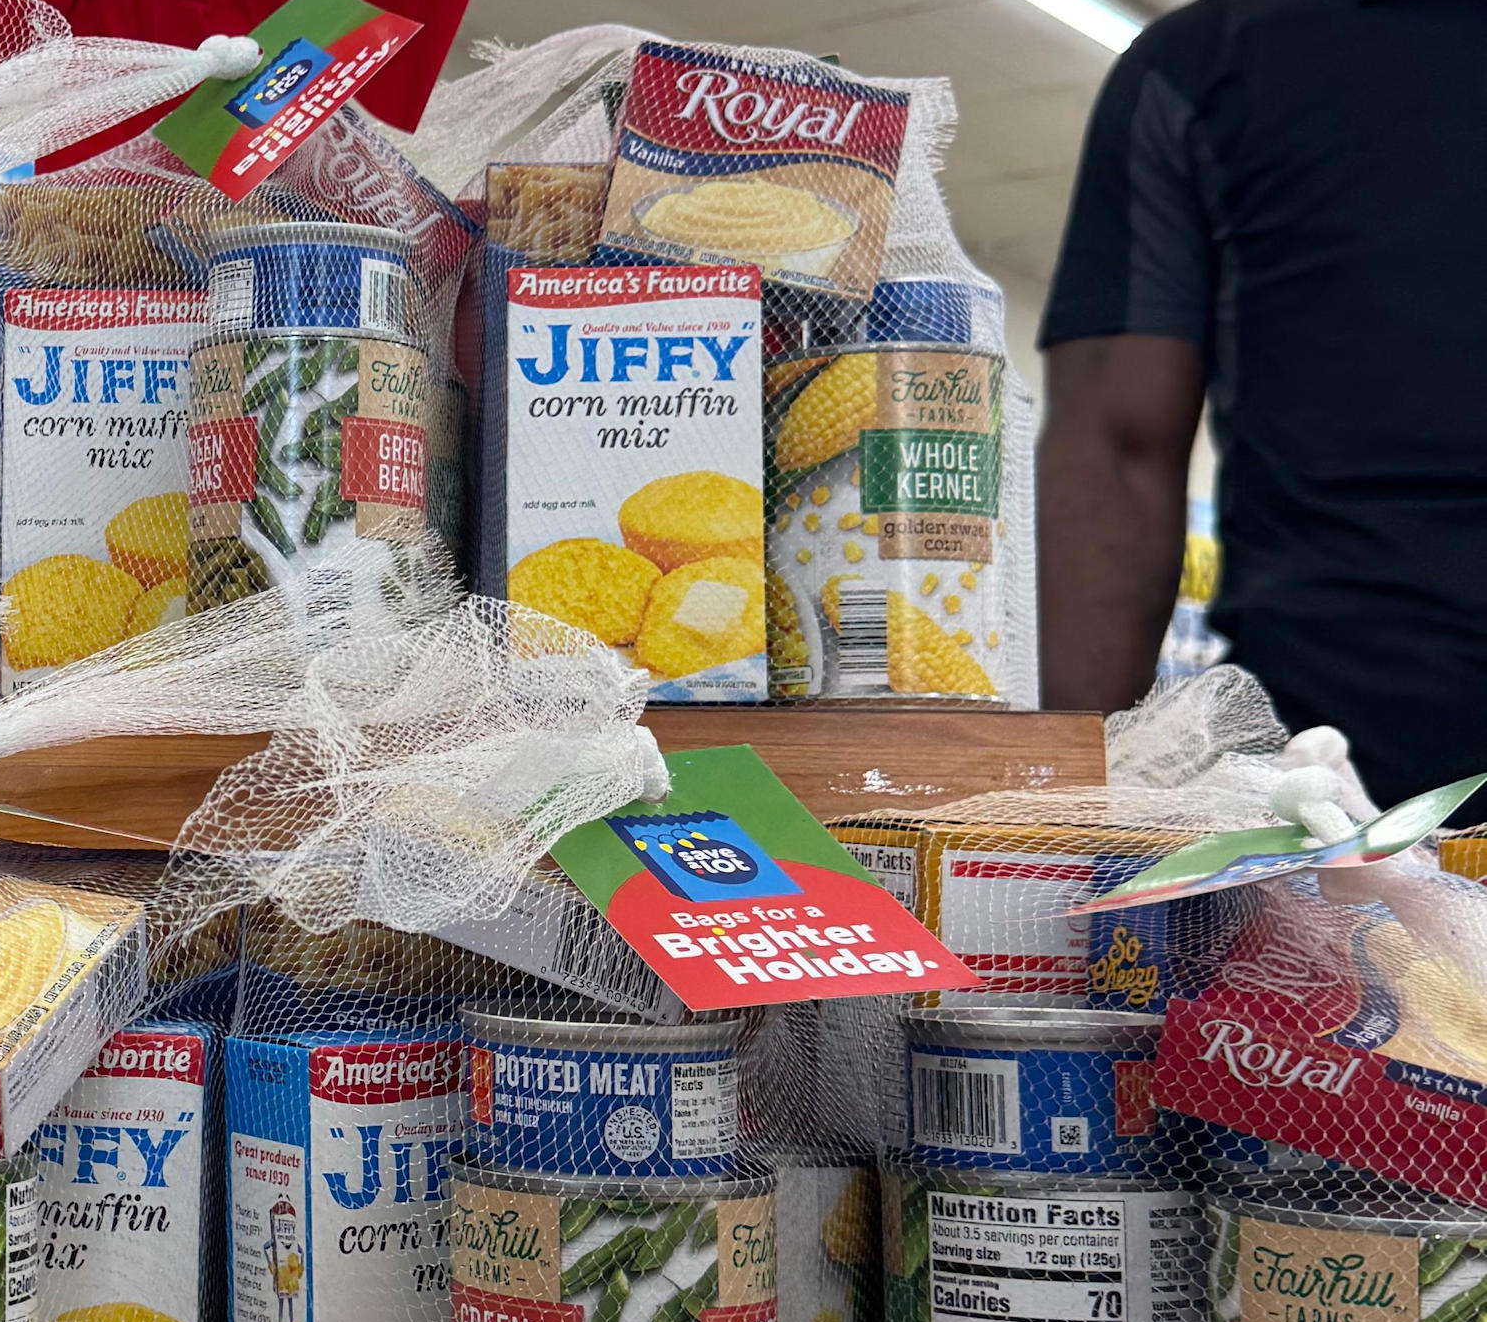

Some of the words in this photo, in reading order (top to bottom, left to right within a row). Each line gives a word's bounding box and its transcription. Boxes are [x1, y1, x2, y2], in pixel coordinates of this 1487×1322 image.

[232, 47, 368, 176] Brighter
[676, 69, 864, 146] Royal
[628, 140, 685, 169] Vanilla
[516, 272, 641, 299] America's
[647, 270, 751, 295] Favorite
[12, 295, 128, 318] America's
[581, 322, 619, 337] Quality
[622, 322, 641, 333] and
[644, 321, 673, 332] Value
[677, 322, 702, 332] since
[706, 321, 730, 331] 1930
[892, 369, 982, 405] Fairhill
[529, 395, 607, 418] corn
[616, 388, 738, 419] muffin
[24, 415, 96, 438] corn
[598, 421, 669, 449] mix
[87, 440, 153, 468] mix
[901, 442, 980, 473] WHOLE
[896, 472, 982, 503] KERNEL
[884, 518, 953, 540] golden
[925, 536, 963, 551] corn
[678, 847, 736, 863] save
[671, 911, 750, 929] Bags
[753, 906, 802, 923] for
[805, 906, 824, 919] a
[653, 923, 876, 960] Brighter
[1107, 927, 1142, 961] So
[715, 949, 939, 985] Holiday.
[1089, 955, 1159, 1006] Cheezy
[322, 1053, 454, 1087] America's
[1200, 1019, 1362, 1098] Royal
[495, 1054, 580, 1093] POTTED
[590, 1062, 660, 1096] MEAT
[1405, 1094, 1461, 1125] Vanilla
[931, 1196, 1036, 1224] Nutrition
[1047, 1205, 1120, 1226] Facts
[339, 1217, 428, 1254] corn
[451, 1210, 544, 1262] Fairhill
[932, 1223, 960, 1238] About
[963, 1226, 980, 1240] 3.5
[985, 1229, 1034, 1246] servings
[1039, 1234, 1059, 1247] per
[1064, 1234, 1119, 1247] container
[1253, 1246, 1398, 1311] Fairhill
[934, 1285, 1011, 1313] Calories
[1088, 1291, 1122, 1318] 70
